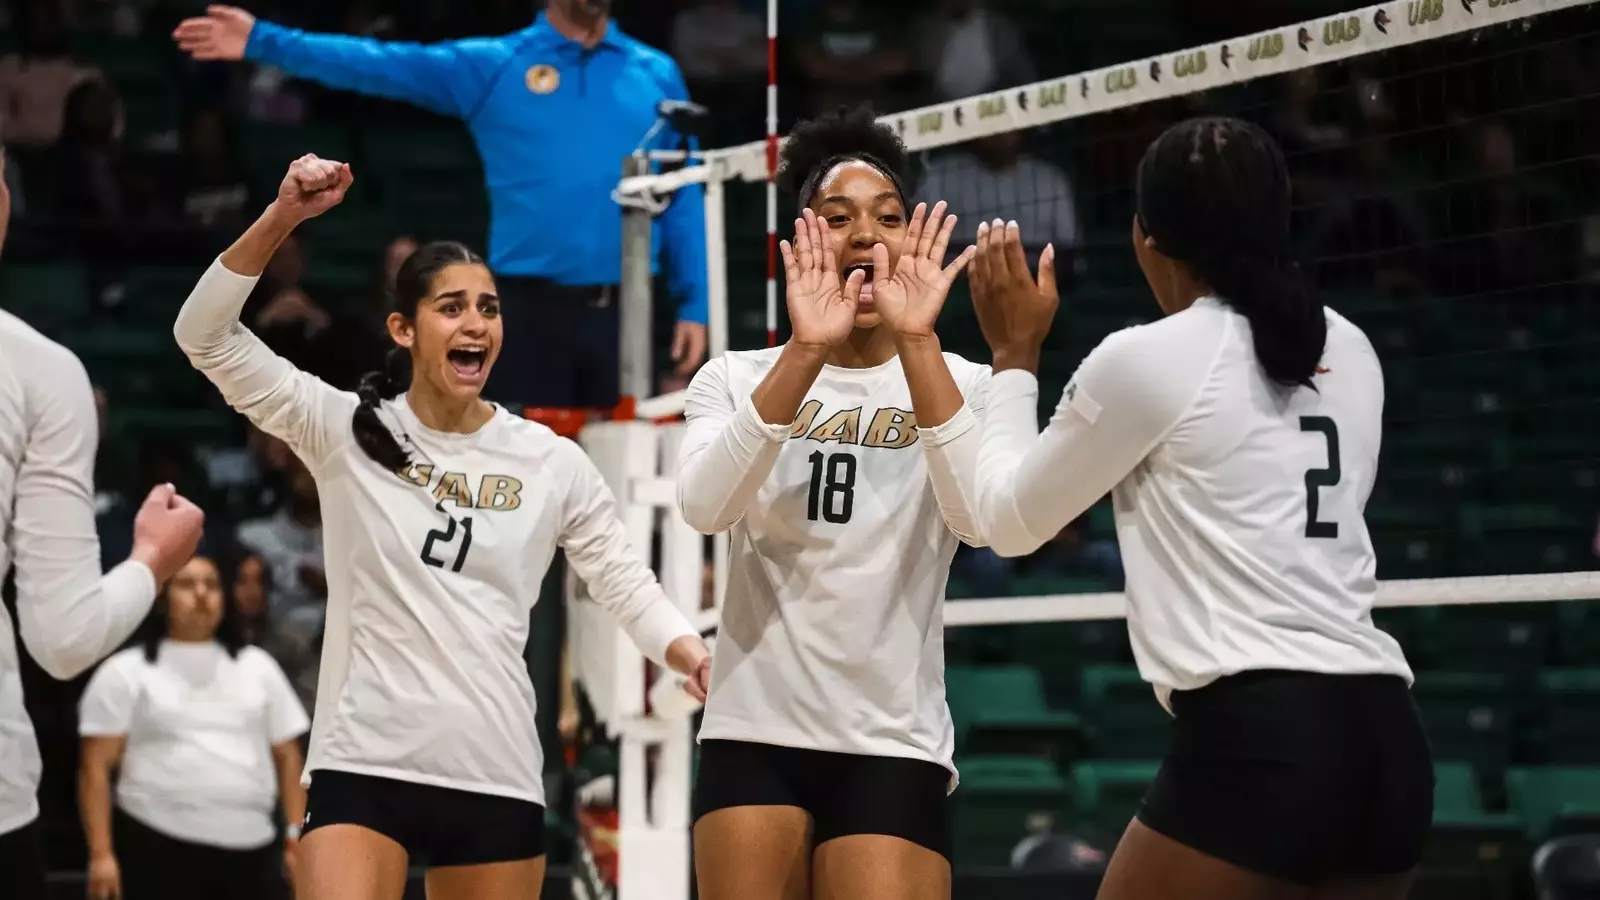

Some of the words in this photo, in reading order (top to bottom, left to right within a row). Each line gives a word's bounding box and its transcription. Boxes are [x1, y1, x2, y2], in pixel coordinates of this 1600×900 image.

[1247, 33, 1284, 62] UAB
[1323, 16, 1361, 46] UAB
[1408, 0, 1445, 27] UAB
[807, 449, 857, 524] 18
[1299, 415, 1341, 538] 2
[420, 499, 473, 573] 21
